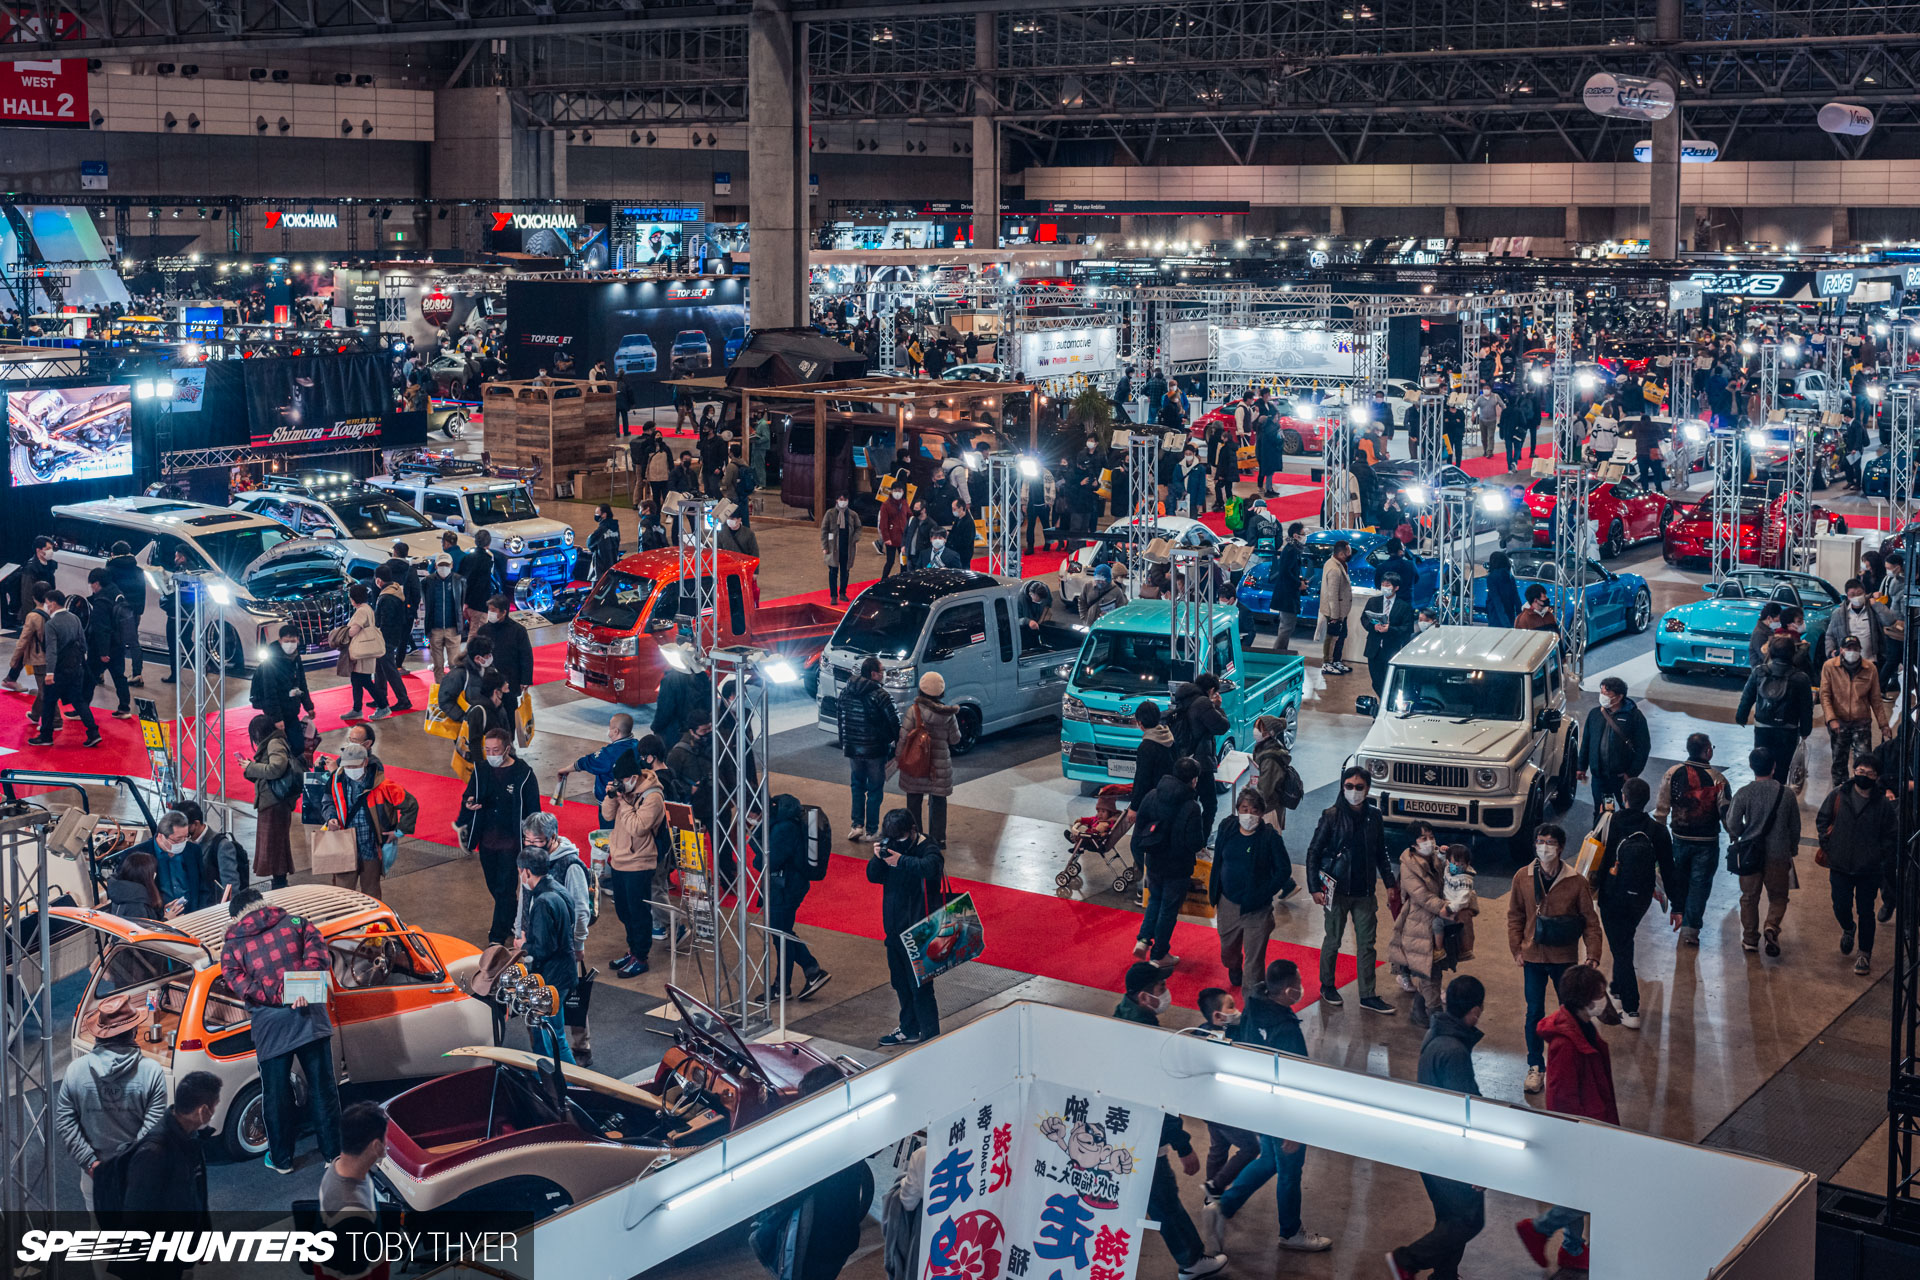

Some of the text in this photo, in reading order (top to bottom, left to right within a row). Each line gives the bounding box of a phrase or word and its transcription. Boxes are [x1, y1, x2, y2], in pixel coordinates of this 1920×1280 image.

[21, 76, 56, 88] WEST
[3, 93, 74, 117] HALL 2
[98, 164, 104, 174] 2
[281, 213, 338, 228] YOKOHAMA
[513, 213, 577, 229] YOKOHAMA
[1822, 272, 1854, 295] RAYS
[676, 289, 690, 298] TOP
[530, 334, 546, 343] TOP
[1056, 338, 1091, 349] automotive
[268, 421, 376, 444] Shimura Kougyo
[1405, 800, 1457, 814] AEROOVER
[903, 932, 921, 960] 2023
